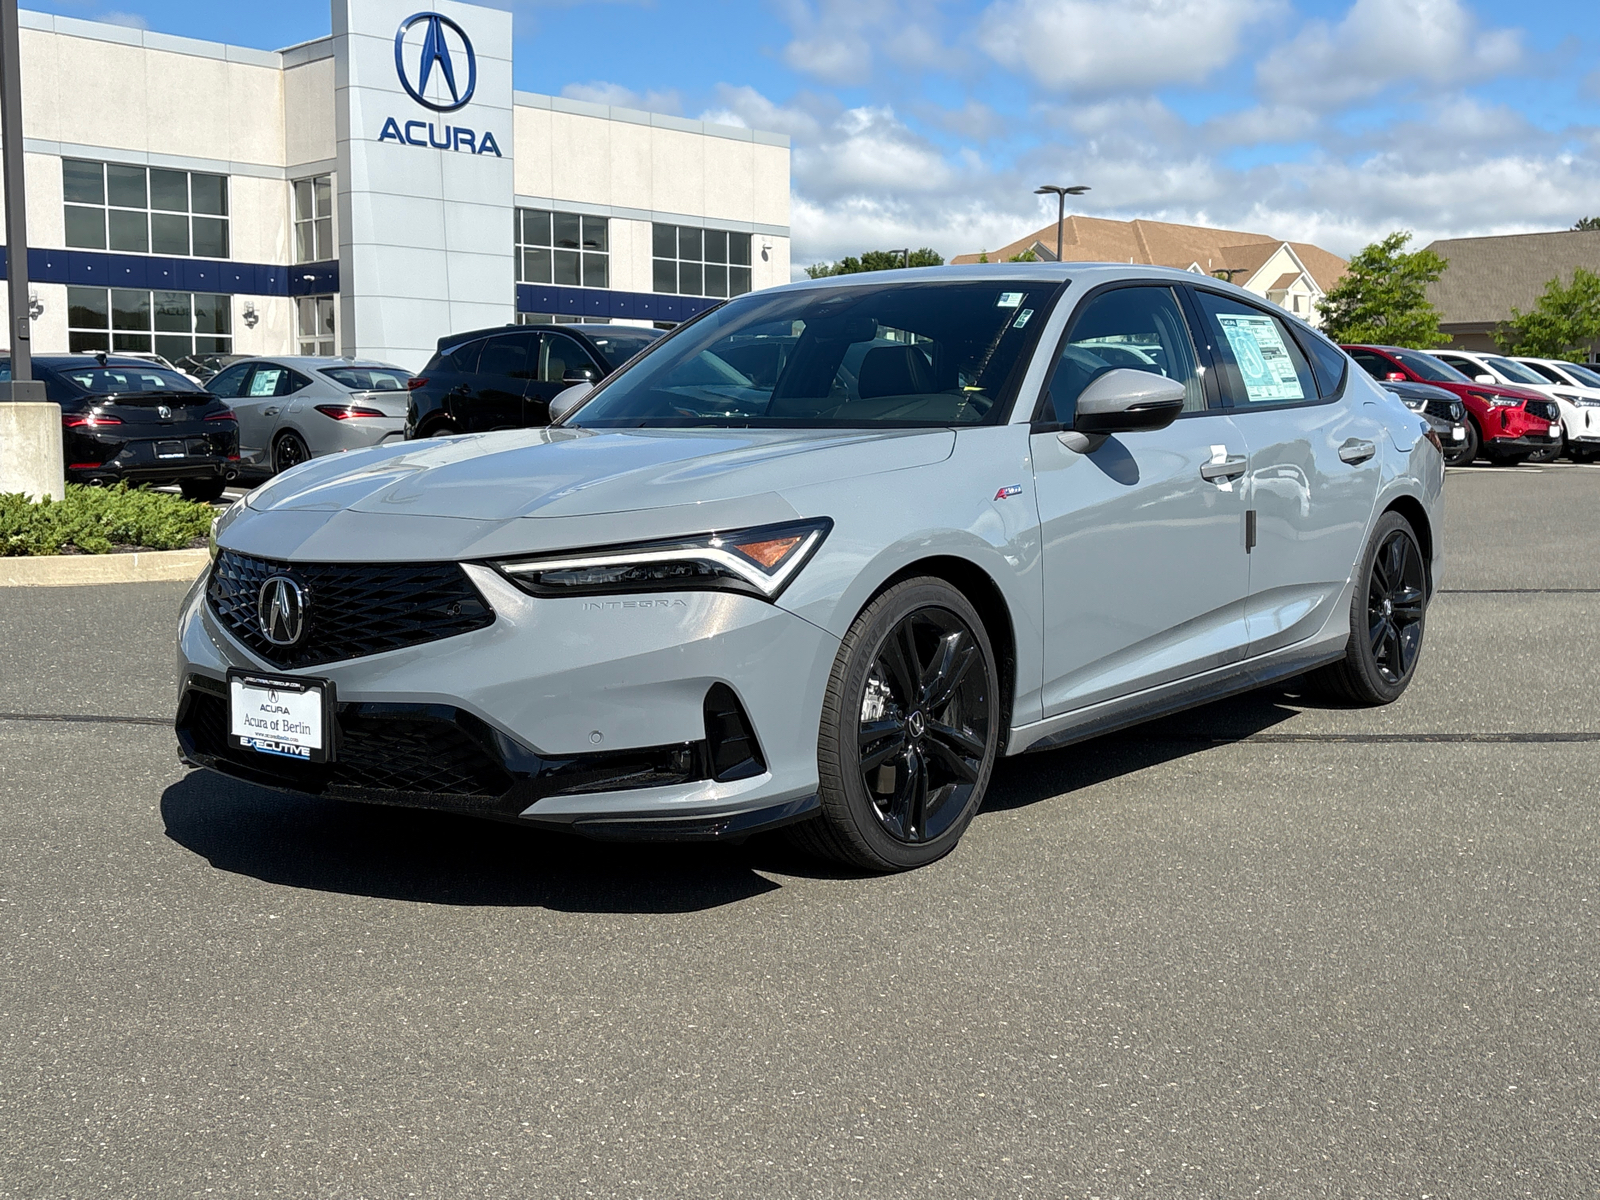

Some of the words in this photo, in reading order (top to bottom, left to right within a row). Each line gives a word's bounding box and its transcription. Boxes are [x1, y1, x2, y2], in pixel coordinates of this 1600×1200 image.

[377, 116, 502, 158] ACURA
[582, 599, 687, 610] INTEGRA
[260, 703, 290, 715] ACURA
[244, 713, 268, 729] Acura
[270, 720, 280, 730] of
[282, 719, 311, 735] Berlin
[240, 736, 311, 756] EXECUTIVE
